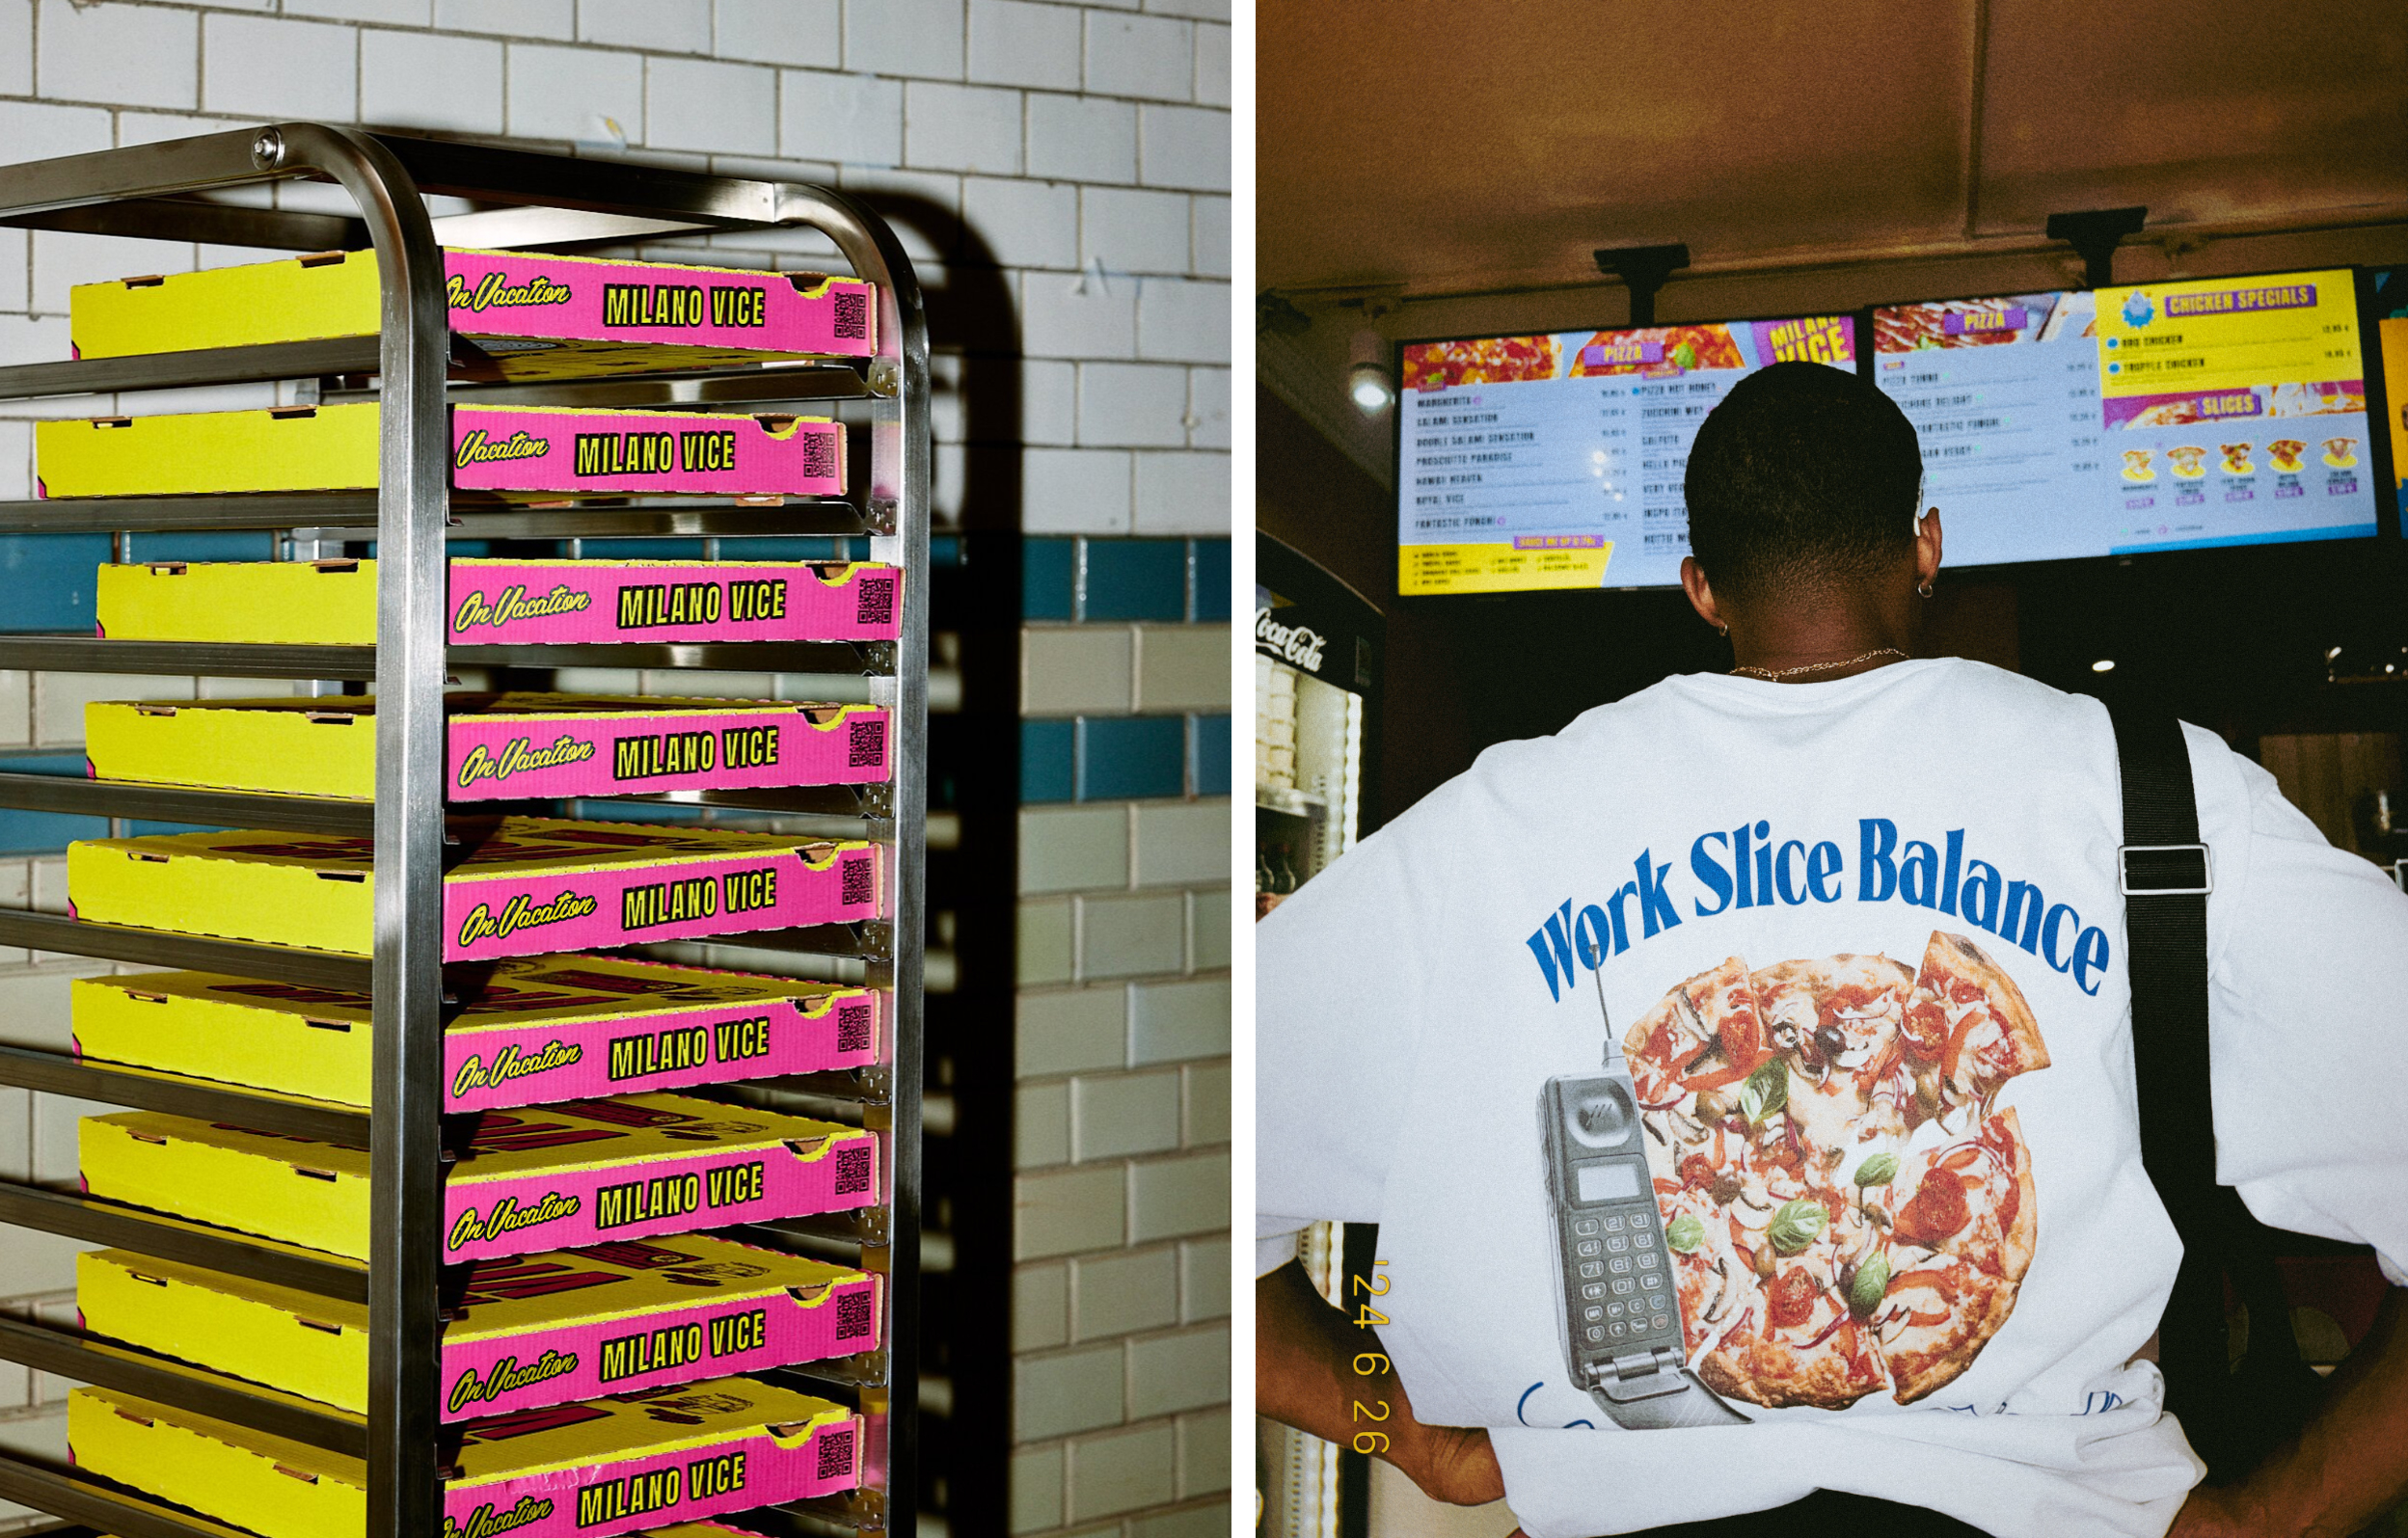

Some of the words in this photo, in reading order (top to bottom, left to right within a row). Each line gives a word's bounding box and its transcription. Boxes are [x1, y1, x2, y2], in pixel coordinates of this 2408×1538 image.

[473, 272, 571, 312] Vacation
[604, 284, 704, 326] MILANO
[712, 288, 766, 326] VICE
[2170, 291, 2233, 314] CHICKEN
[2238, 287, 2310, 310] SPECIALS
[1963, 311, 2005, 331] PIZZA
[2144, 335, 2182, 345] CHICKEN
[1603, 345, 1643, 363] PIZZA
[2165, 358, 2205, 368] CHICKEN
[2202, 395, 2255, 415] SLICES
[455, 430, 550, 469] Vacation
[576, 433, 674, 476] MILANO
[681, 431, 736, 471] VICE
[454, 591, 493, 632] On
[492, 584, 591, 627] Vacation
[617, 580, 720, 630] MILANO
[729, 579, 787, 622] VICE
[459, 745, 497, 788] On
[497, 736, 595, 779] Vacation
[614, 730, 716, 781] MILANO
[721, 725, 779, 769] VICE
[459, 904, 498, 947] On
[498, 891, 597, 938] Vacation
[622, 877, 717, 931] MILANO
[725, 869, 777, 911] VICE
[1525, 847, 1683, 1004] Work
[1690, 819, 1844, 917] Slice
[1857, 818, 2111, 997] Balance
[452, 1055, 488, 1098] On
[488, 1040, 582, 1089] Vacation
[609, 1027, 707, 1081] MILANO
[716, 1017, 771, 1062] VICE
[595, 1174, 699, 1229] MILANO
[708, 1161, 765, 1210] VICE
[448, 1208, 485, 1251] On
[485, 1193, 581, 1245] Vacation
[600, 1324, 702, 1383] MILANO
[711, 1309, 767, 1360] VICE
[448, 1369, 484, 1413] On
[484, 1350, 577, 1403] Vacation
[578, 1469, 682, 1529] MILANO
[690, 1452, 747, 1504] VICE
[465, 1496, 554, 1538] Vacation
